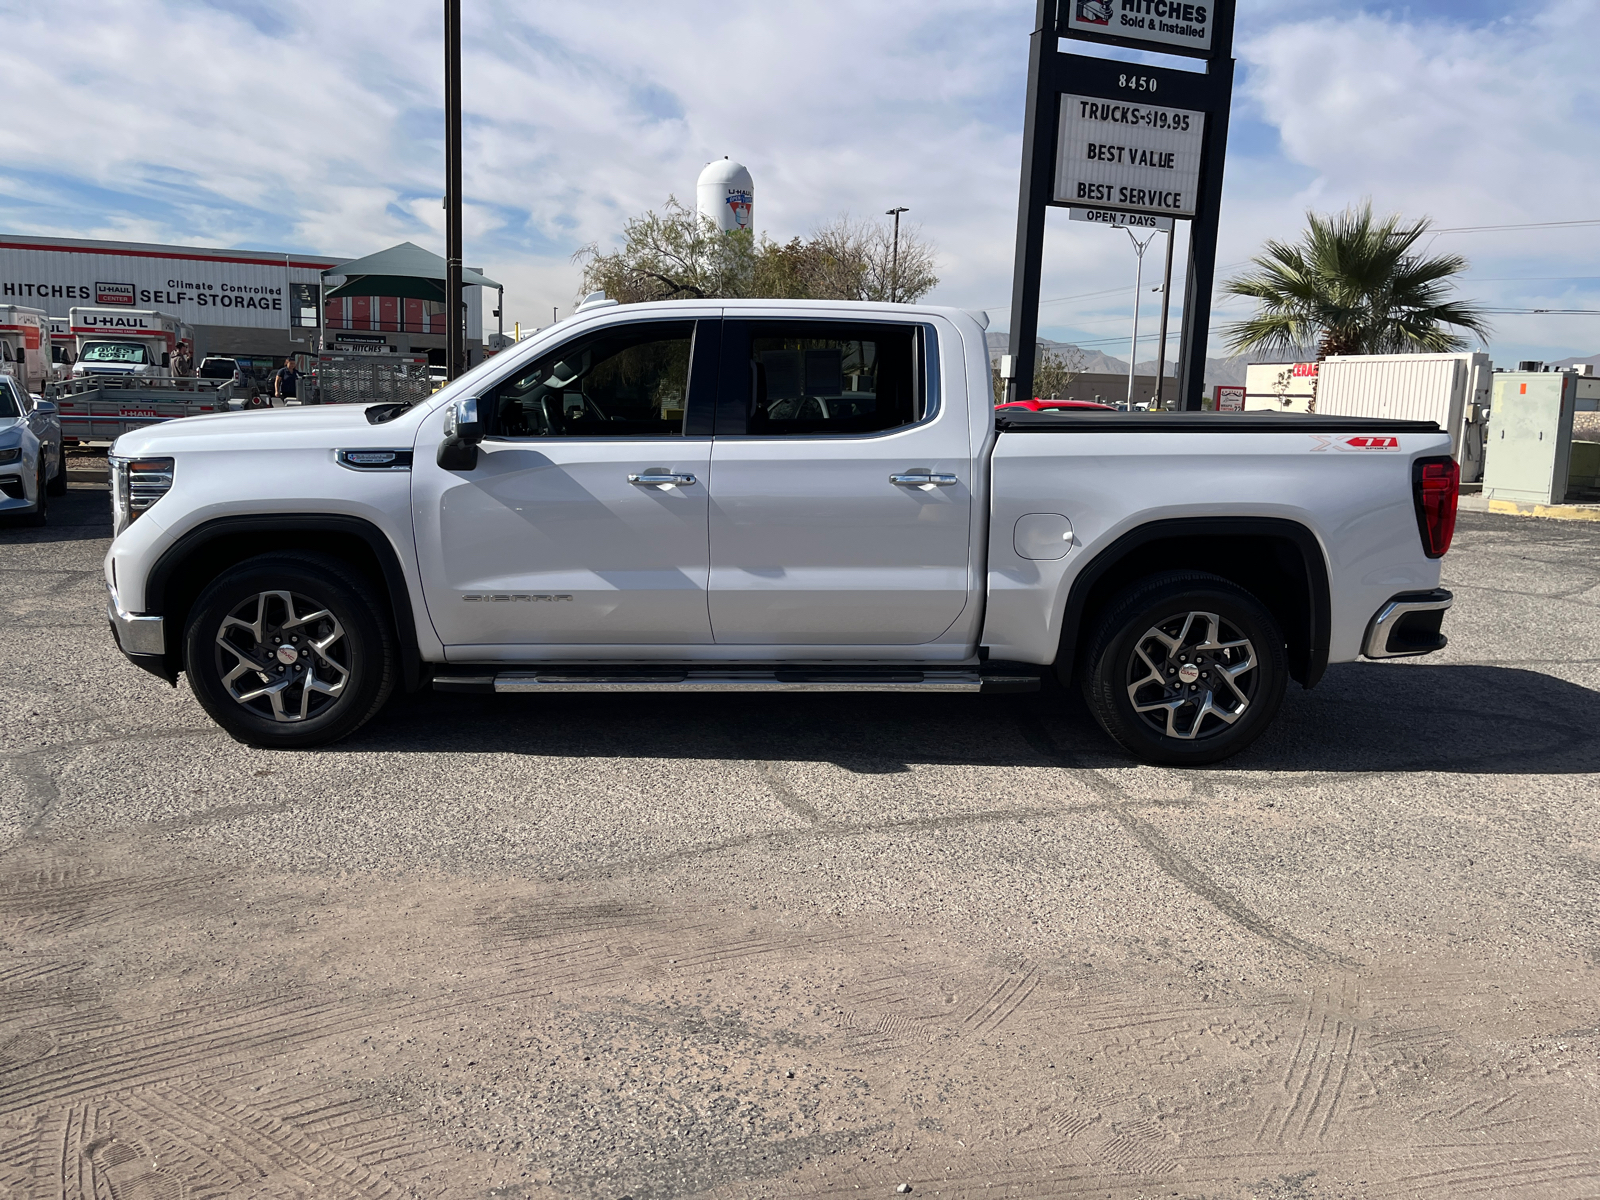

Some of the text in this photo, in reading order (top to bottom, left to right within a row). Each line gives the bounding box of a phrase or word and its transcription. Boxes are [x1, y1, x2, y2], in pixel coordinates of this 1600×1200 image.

[1121, 0, 1206, 24] HITCHES
[1120, 13, 1205, 38] Sold & Installed
[1118, 74, 1157, 92] 8450
[1087, 143, 1175, 169] BEST VALUE
[1077, 182, 1181, 209] BEST SERVICE
[1086, 210, 1156, 227] OPEN 7 DAYS
[3, 283, 91, 299] HITCHES
[167, 280, 282, 295] Climate Controlled
[140, 290, 282, 310] SELF-STORAGE
[92, 346, 135, 354] LOWEST
[462, 594, 573, 602] SIERRA
[280, 648, 295, 661] GMC
[1180, 669, 1197, 678] GMC
